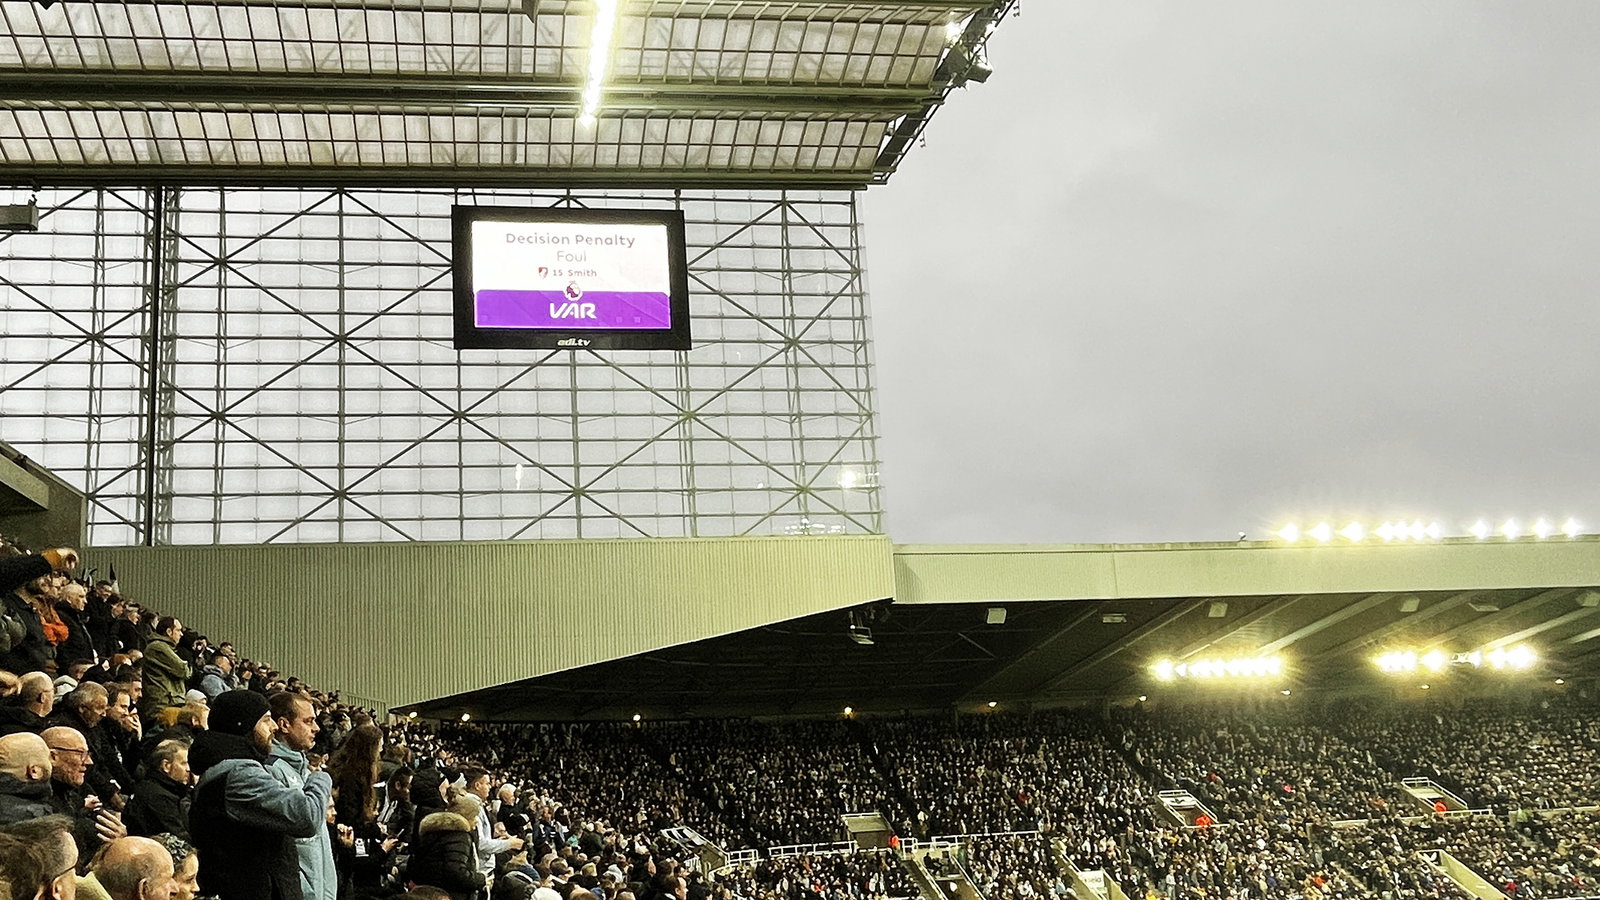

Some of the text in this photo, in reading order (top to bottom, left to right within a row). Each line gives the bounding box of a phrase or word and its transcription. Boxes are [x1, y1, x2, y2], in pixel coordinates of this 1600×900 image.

[505, 232, 635, 249] Decision Penalty
[557, 250, 587, 262] Foul
[552, 269, 597, 277] 15 Smith
[550, 302, 597, 319] VAR
